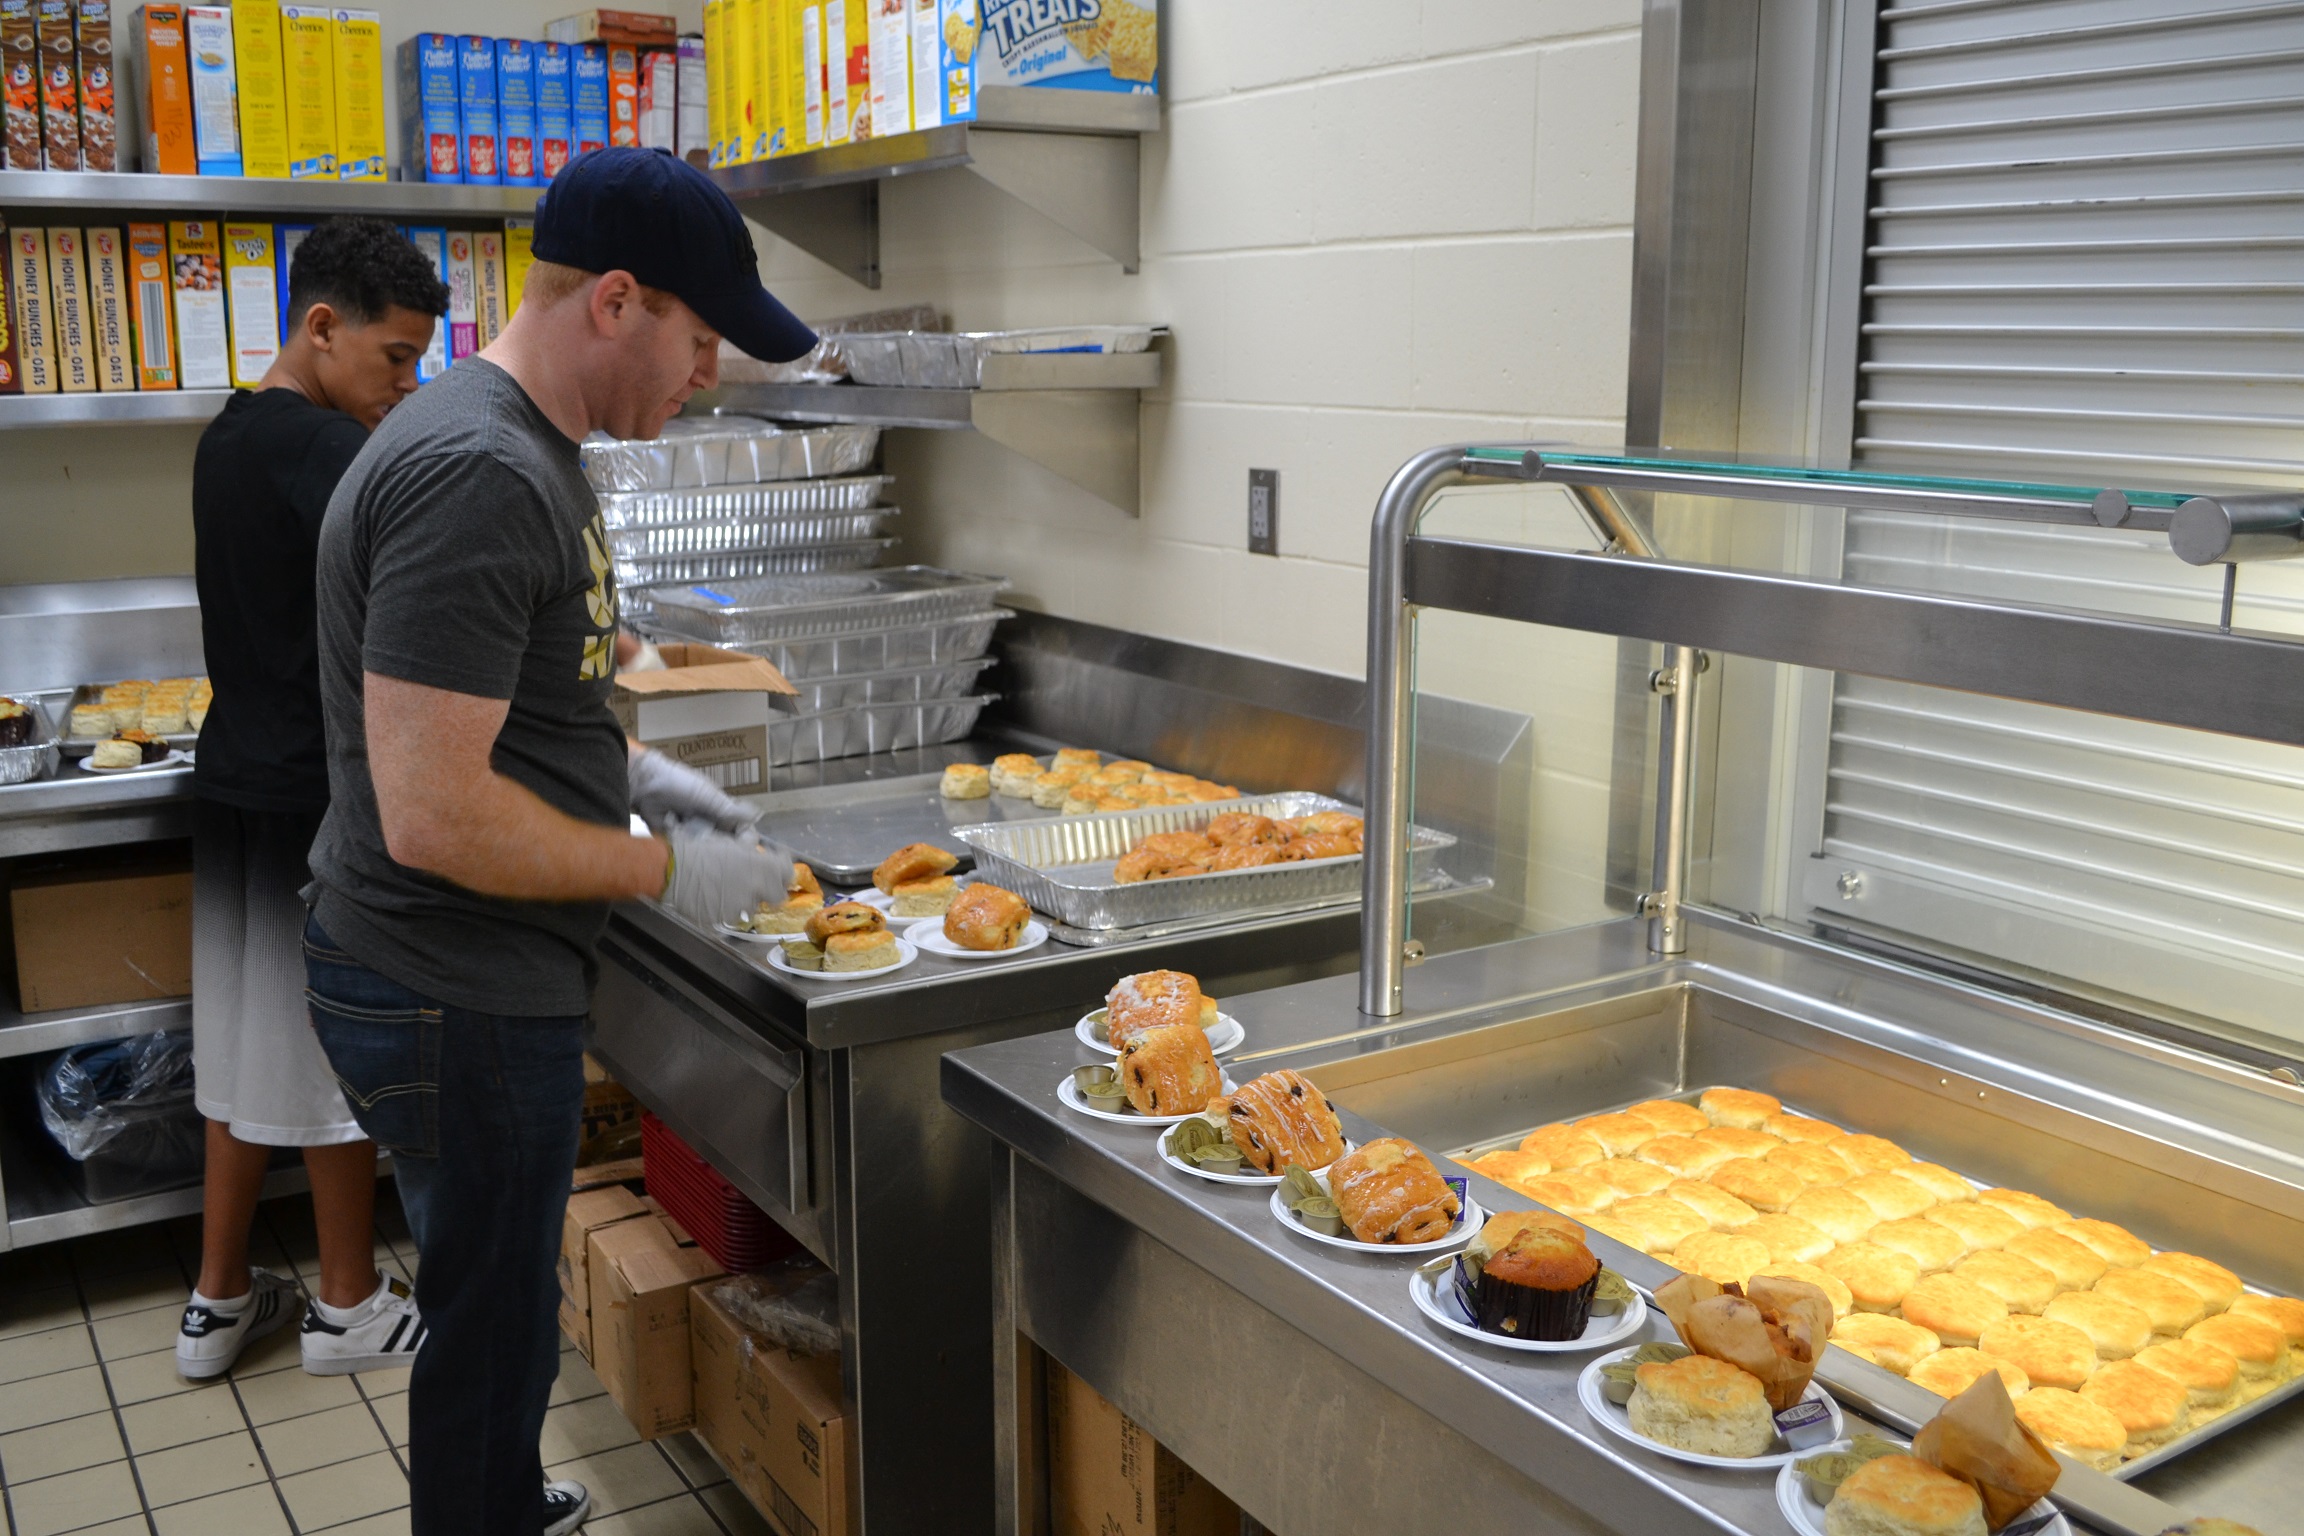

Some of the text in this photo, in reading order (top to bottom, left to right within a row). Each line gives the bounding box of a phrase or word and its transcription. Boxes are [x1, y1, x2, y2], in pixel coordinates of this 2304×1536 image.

[290, 21, 325, 33] Cheerios
[339, 24, 373, 36] Cheerios
[1019, 45, 1068, 75] Original
[24, 258, 38, 295] HONEY
[62, 258, 76, 295] HONEY
[101, 258, 115, 295] HONEY
[28, 299, 42, 347] BUNCHES
[66, 298, 81, 347] BUNCHES
[105, 298, 119, 346] BUNCHES
[33, 357, 46, 386] OATS
[71, 356, 85, 385] OATS
[110, 356, 123, 384] OATS
[677, 735, 716, 760] COUNTRY
[717, 733, 747, 751] CROCK
